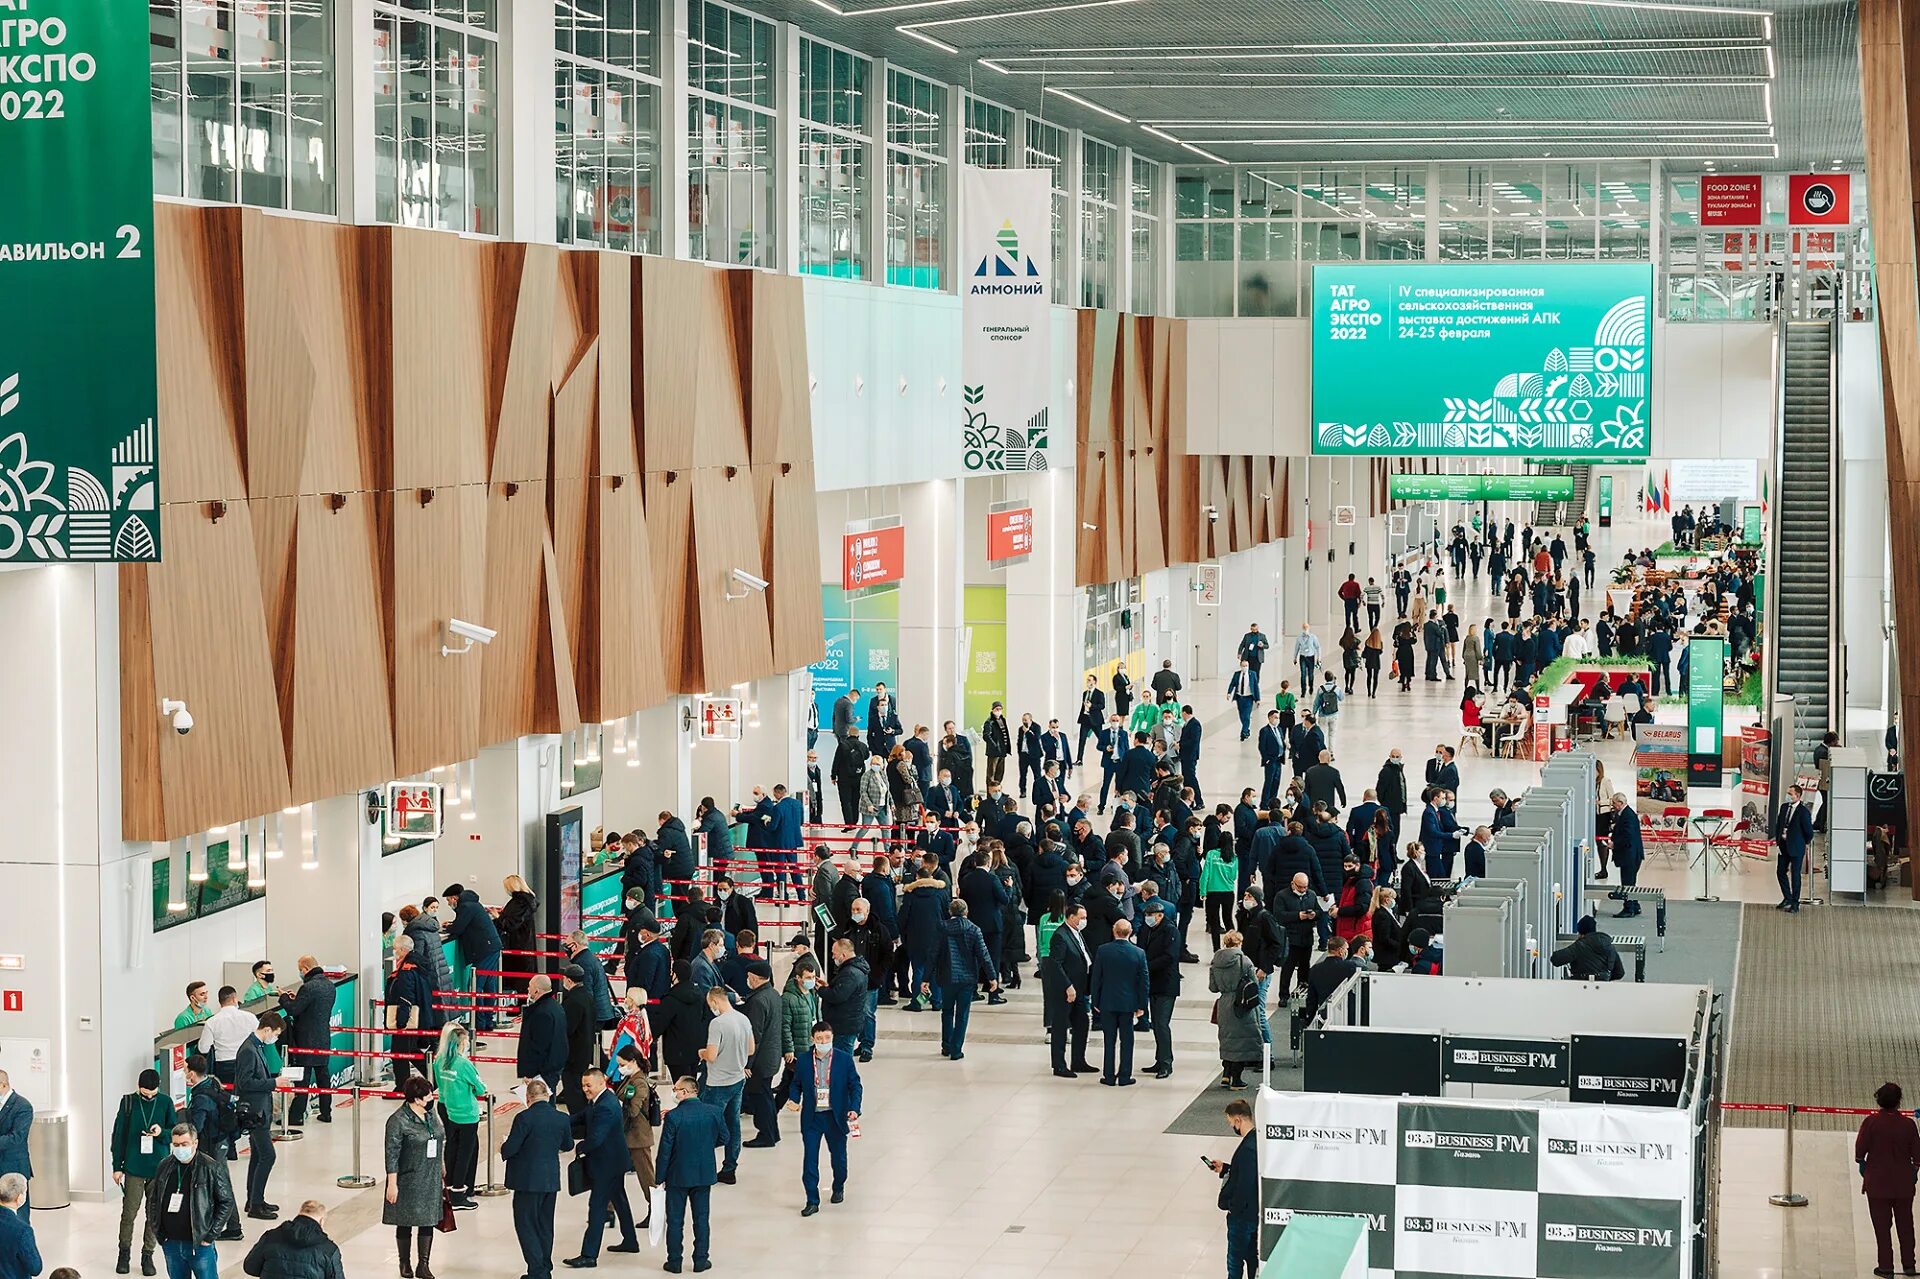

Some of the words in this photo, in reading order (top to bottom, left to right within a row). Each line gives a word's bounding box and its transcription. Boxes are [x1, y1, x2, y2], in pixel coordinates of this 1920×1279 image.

[0, 17, 67, 47] ГРО
[116, 224, 141, 259] 2
[970, 282, 1043, 294] АММОНИЙ
[1330, 285, 1356, 297] ТАТ
[1399, 286, 1412, 297] IV
[1414, 287, 1545, 299] специализированная
[1330, 299, 1370, 312] АГРО
[1399, 300, 1534, 312] сельскохозяйственная
[1330, 313, 1382, 326] ЭКСПО
[1399, 315, 1454, 324] выставка
[1456, 313, 1529, 326] достижений
[1532, 312, 1561, 324] АПК
[1330, 328, 1367, 340] 2022
[1398, 327, 1435, 338] 24-25
[1438, 327, 1491, 340] февраля
[1653, 730, 1682, 739] BELARUS
[1480, 1053, 1527, 1064] BUSINESS
[1528, 1052, 1557, 1069] FM
[1604, 1079, 1648, 1088] BUSINESS
[1650, 1078, 1678, 1093] FM
[1298, 1128, 1353, 1140] BUSINESS
[1355, 1128, 1388, 1146] FM
[1437, 1136, 1494, 1148] BUSINESS
[1495, 1134, 1530, 1154] FM
[1454, 1150, 1481, 1158] Казань
[1580, 1143, 1637, 1154] BUSINESS
[1640, 1143, 1673, 1160] FM
[1353, 1213, 1387, 1232] M
[1436, 1221, 1492, 1232] BUSINESS
[1494, 1220, 1527, 1238] FM
[1578, 1229, 1636, 1242] BUSINESS
[1637, 1228, 1673, 1248] FM
